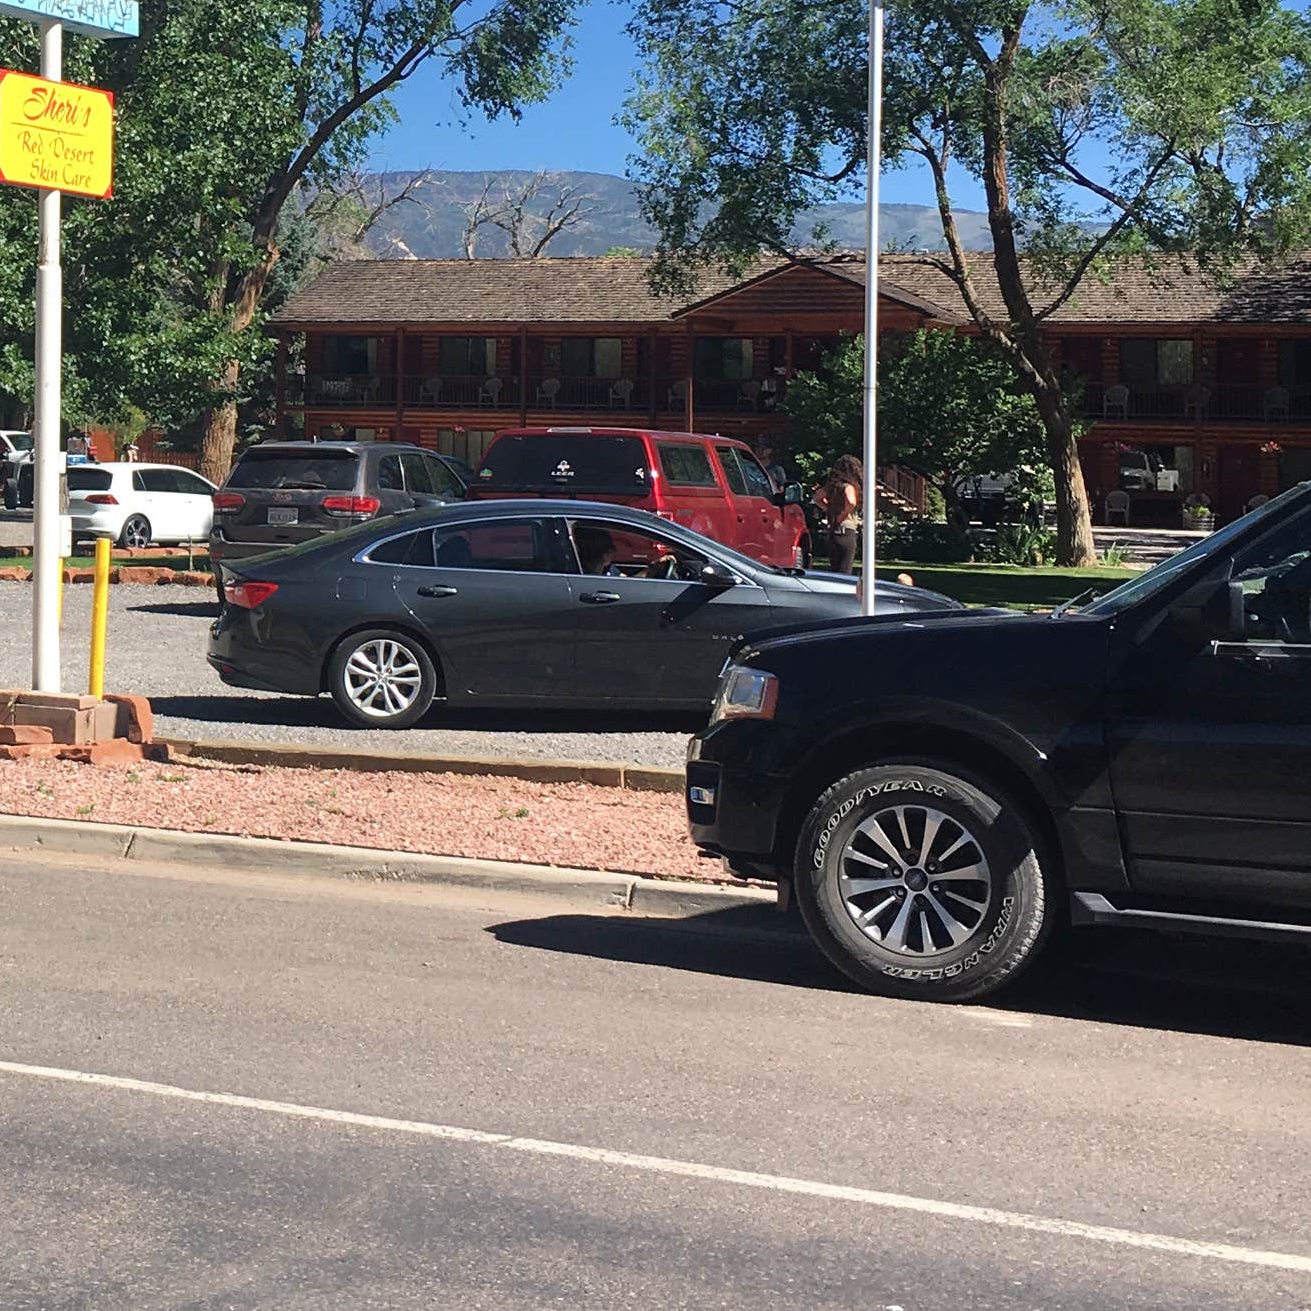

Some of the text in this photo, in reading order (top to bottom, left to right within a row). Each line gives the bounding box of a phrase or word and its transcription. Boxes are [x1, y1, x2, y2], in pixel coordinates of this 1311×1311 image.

[23, 87, 91, 128] Sheri's
[17, 130, 95, 166] Red Desert
[30, 158, 92, 189] Skin Care
[813, 779, 947, 870] GOODYEAR
[881, 896, 1015, 981] WRANGLER
